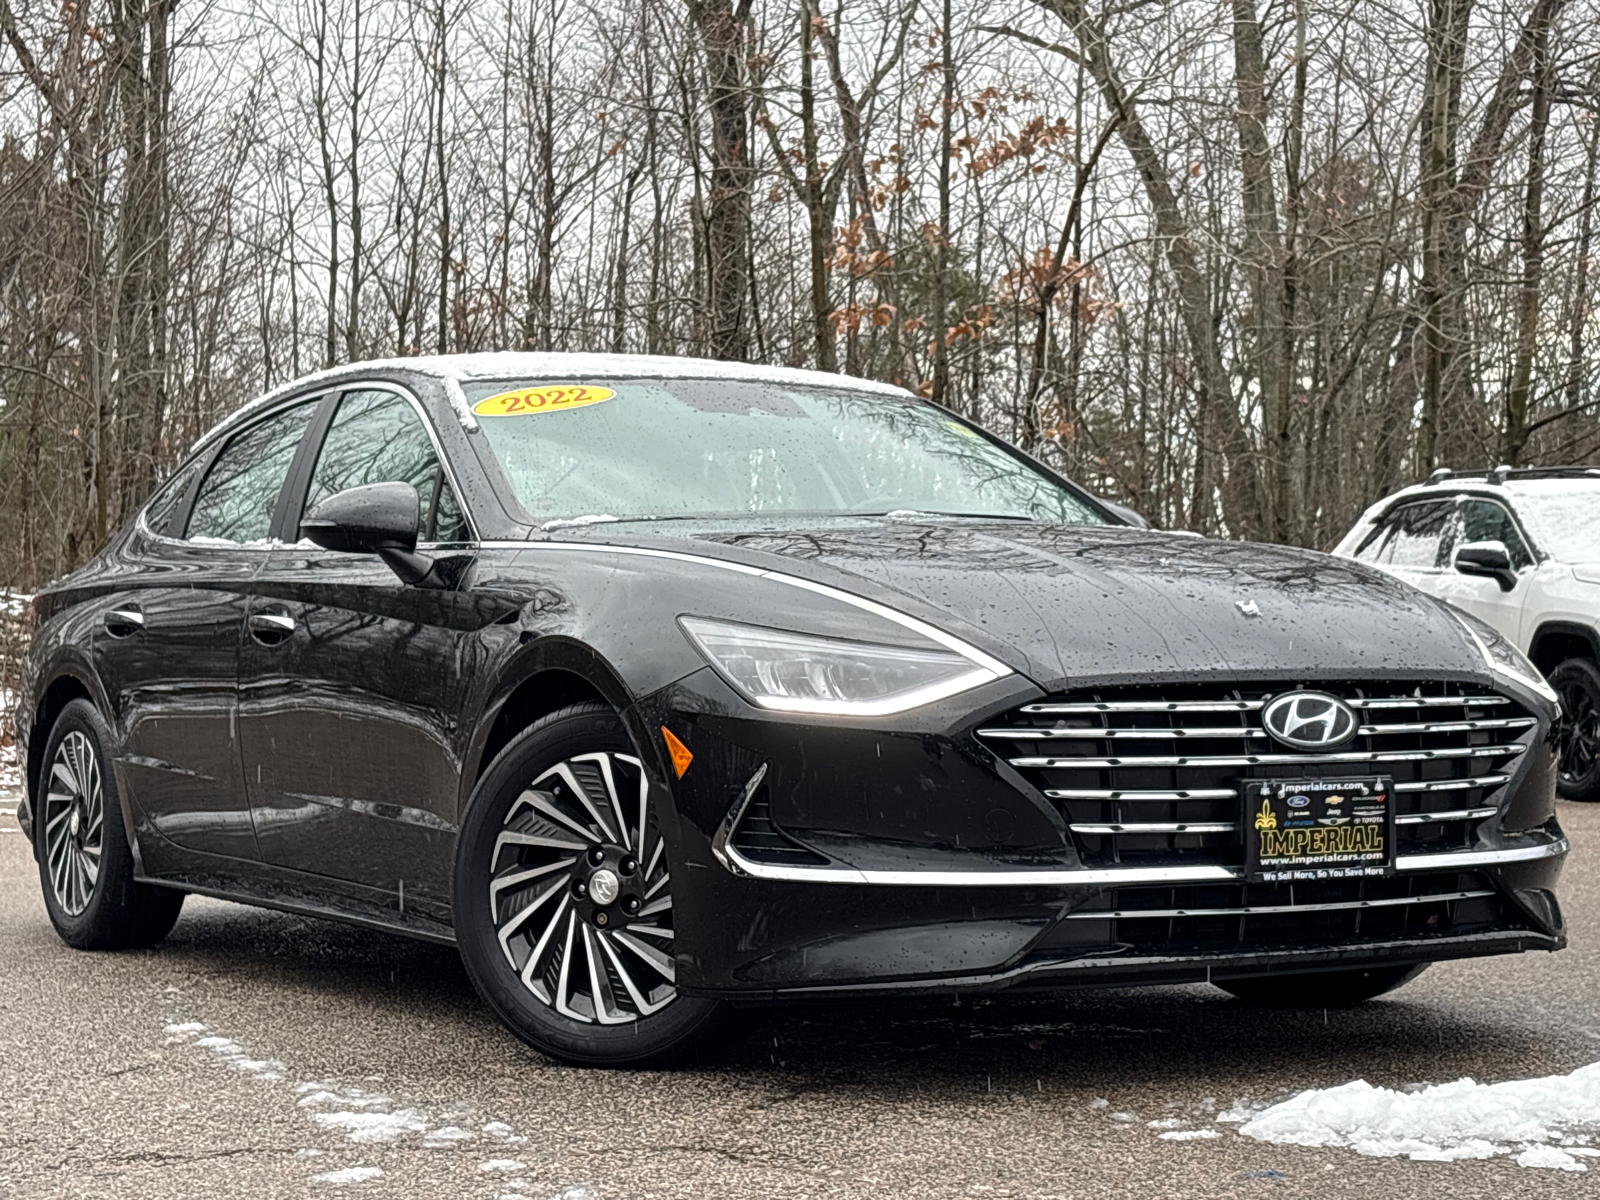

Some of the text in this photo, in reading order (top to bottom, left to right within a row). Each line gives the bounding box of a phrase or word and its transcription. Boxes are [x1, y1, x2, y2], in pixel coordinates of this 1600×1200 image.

[500, 388, 592, 413] 2022
[1281, 781, 1364, 794] Imperialcars.com
[1326, 808, 1341, 816] Jeep
[1260, 825, 1384, 857] IMPERIAL
[1260, 853, 1383, 865] www.imperialcars.com
[1263, 867, 1384, 881] We Sell More, So You Save More
